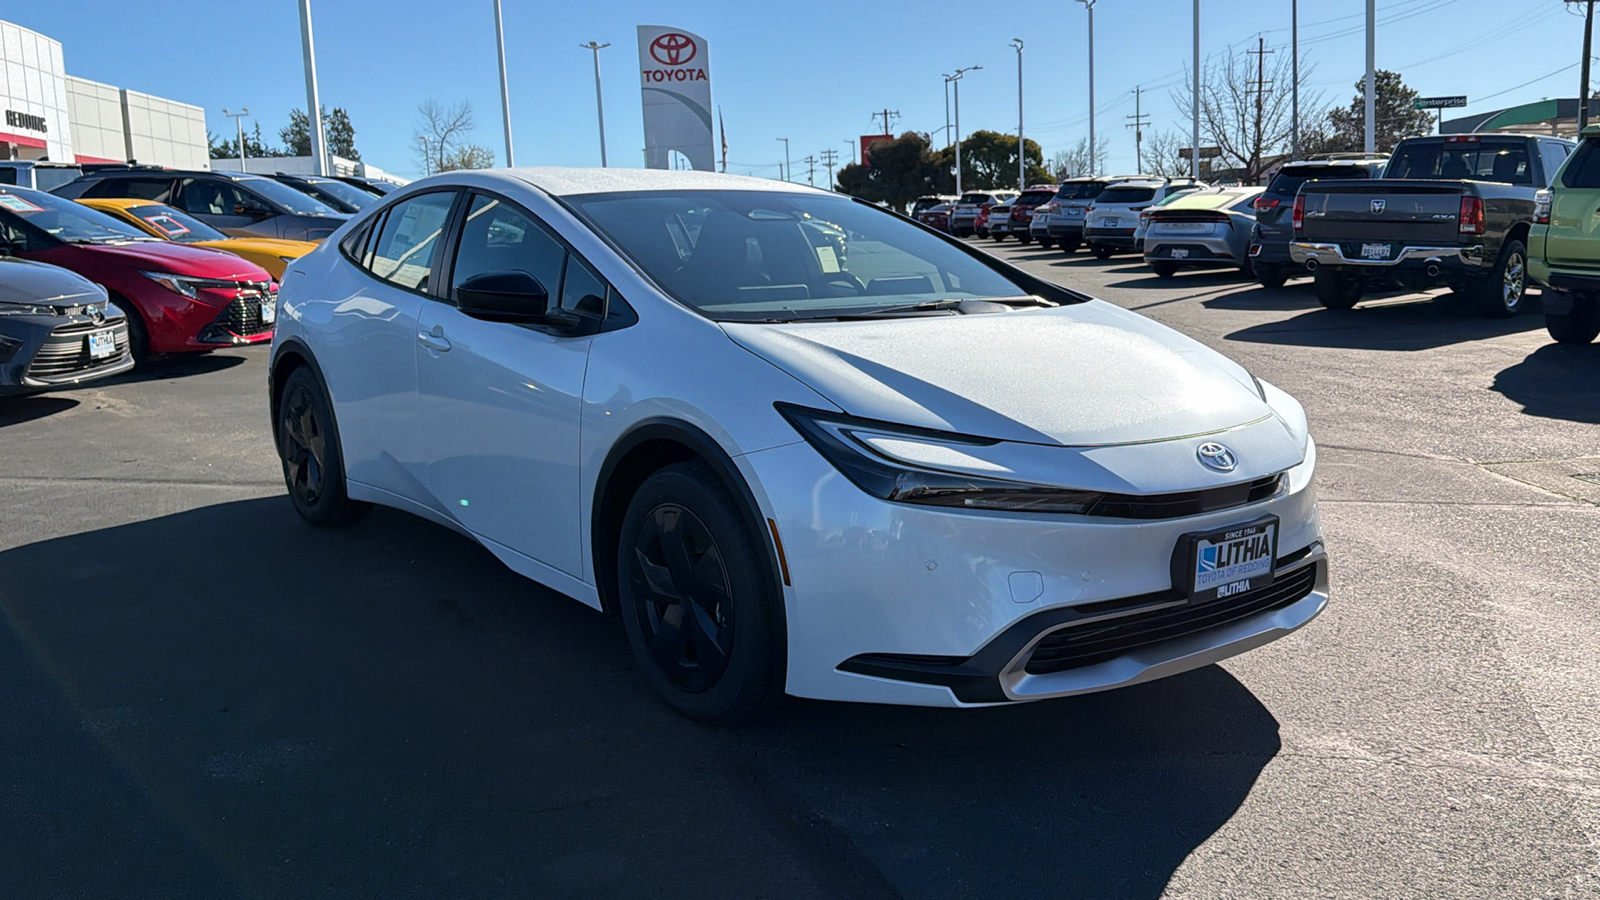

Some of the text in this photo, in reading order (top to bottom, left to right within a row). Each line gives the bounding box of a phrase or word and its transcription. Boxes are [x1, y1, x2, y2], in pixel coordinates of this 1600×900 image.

[643, 69, 707, 82] TOYOTA
[5, 109, 48, 134] REDDING
[1225, 527, 1256, 540] SINCE 1946
[1216, 534, 1270, 569] LITHIA
[1198, 558, 1270, 584] TOYOTA OF REDDING
[1224, 579, 1251, 595] LITHIA
